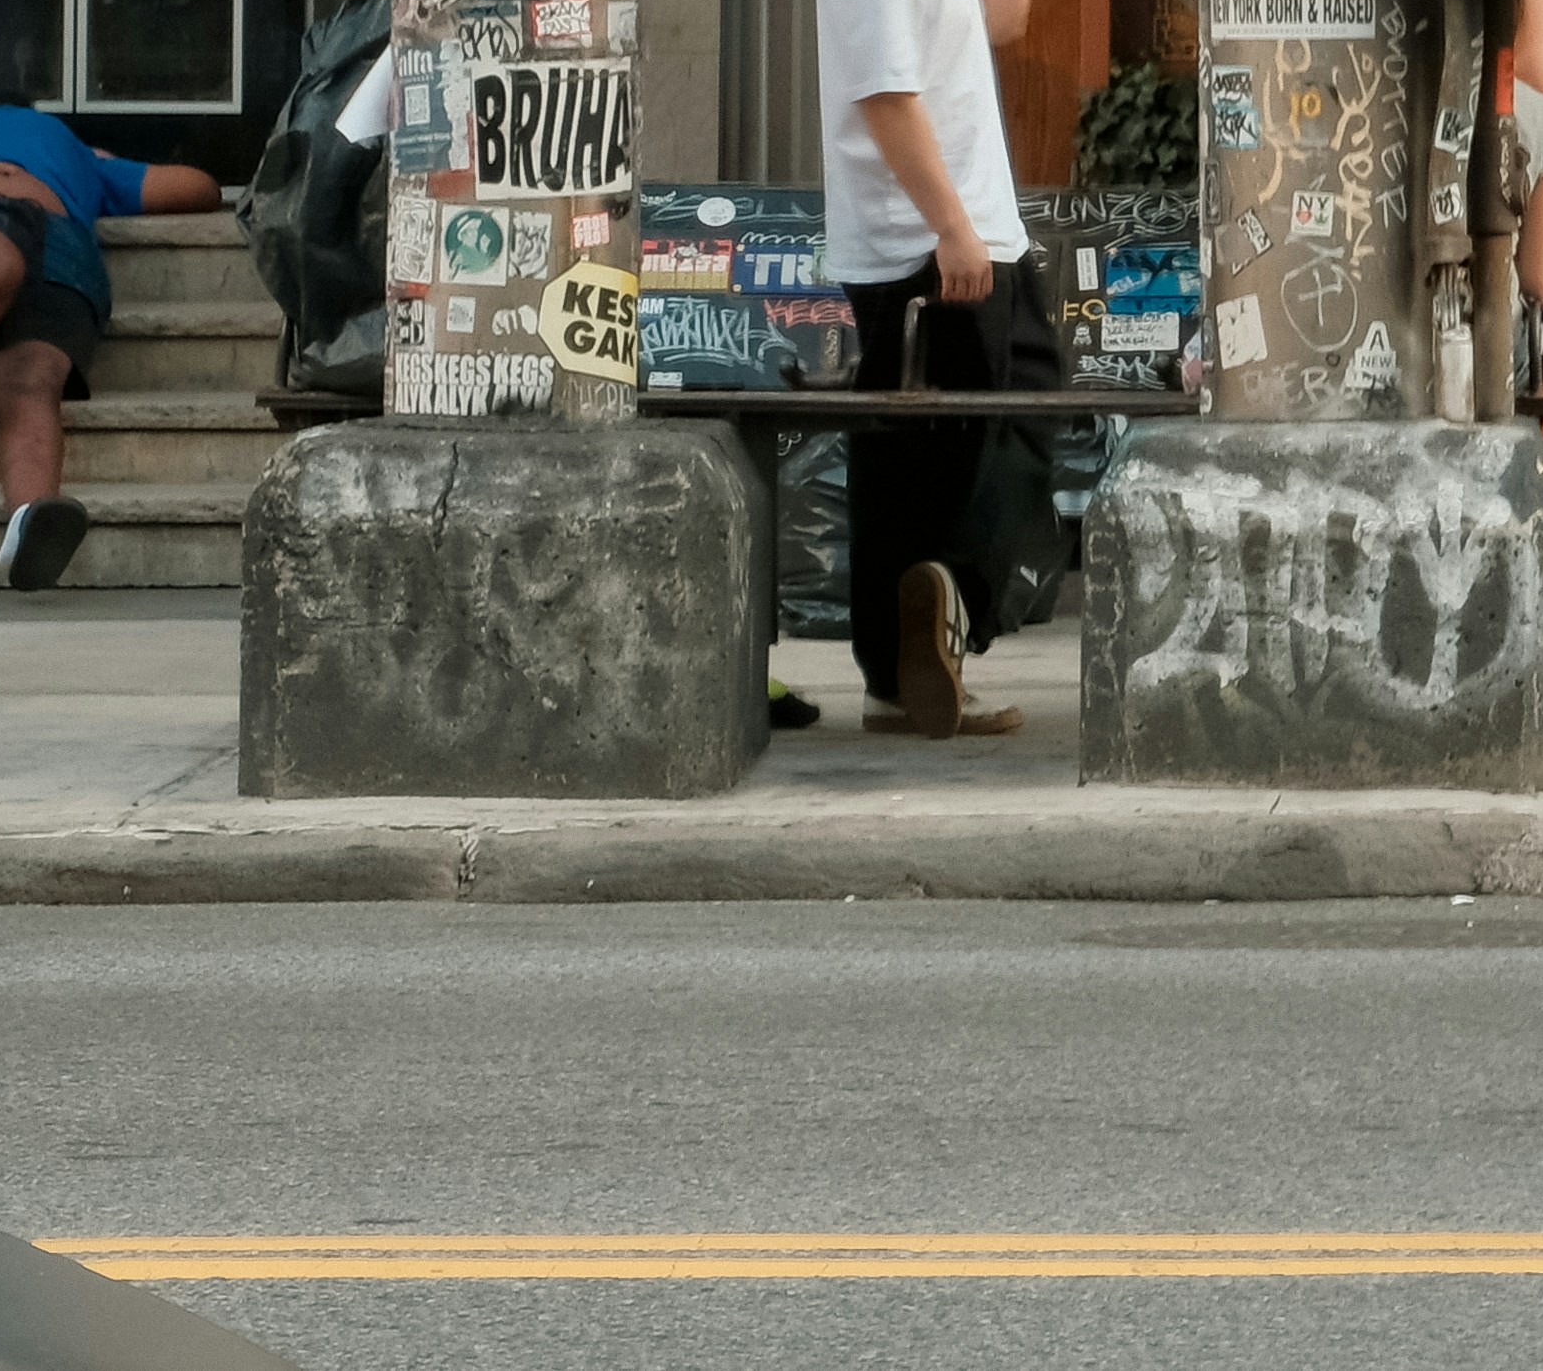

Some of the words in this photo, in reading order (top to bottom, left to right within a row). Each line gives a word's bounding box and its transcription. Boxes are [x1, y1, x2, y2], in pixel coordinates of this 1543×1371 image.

[474, 68, 631, 191] BRUHA
[1297, 195, 1330, 208] NY
[562, 280, 636, 328] KES
[434, 354, 491, 386] KEGS
[493, 354, 554, 386] KEGS
